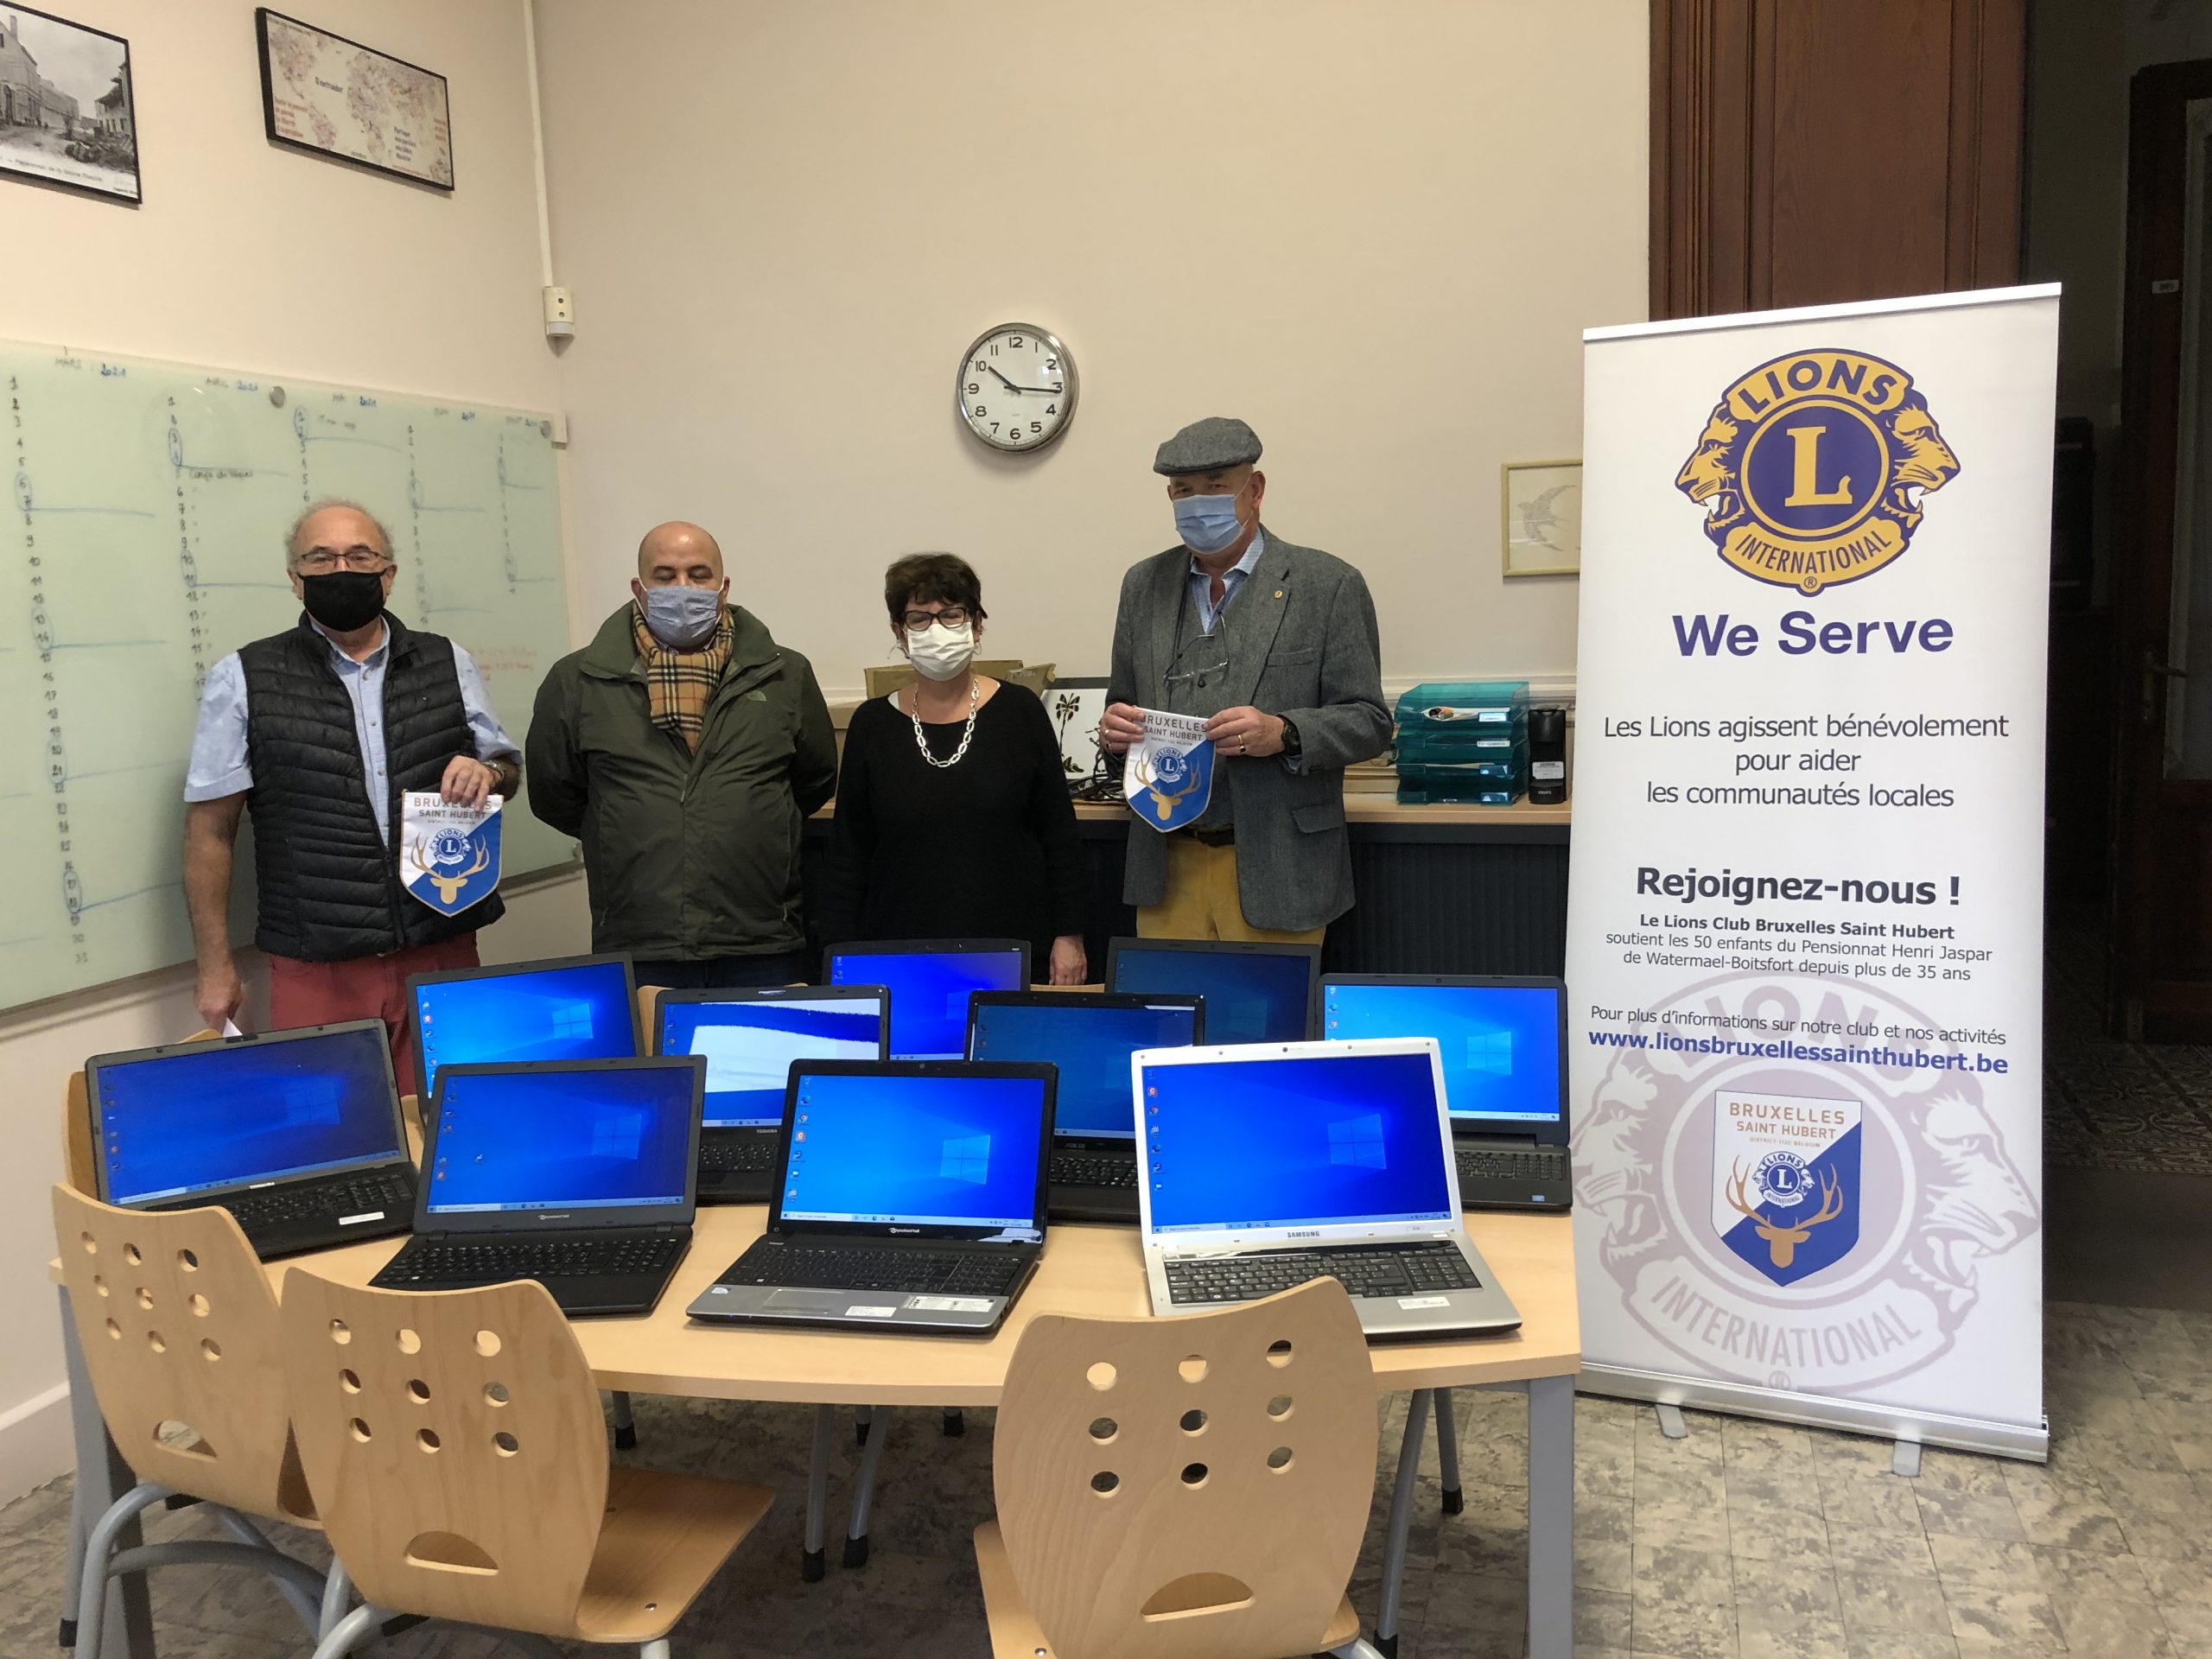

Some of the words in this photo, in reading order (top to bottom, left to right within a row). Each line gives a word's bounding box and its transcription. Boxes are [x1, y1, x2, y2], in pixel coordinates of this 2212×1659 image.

[1009, 336, 1023, 348] 12
[1034, 341, 1038, 353] 1
[990, 345, 998, 356] 11
[976, 360, 987, 372] 10
[1046, 359, 1056, 370] 2
[968, 383, 979, 394] 9
[1052, 382, 1063, 394] 3
[1738, 359, 1897, 415] LIONS
[975, 405, 987, 416] 8
[1046, 404, 1056, 415] 4
[990, 423, 1000, 434] 7
[1010, 428, 1020, 440] 6
[1030, 422, 1042, 433] 5
[1784, 426, 1853, 506] L
[1735, 531, 1891, 574] INTERNATIONAL
[1672, 614, 1758, 657] We
[1778, 611, 1953, 655] Serve
[1144, 726, 1166, 736] SAINT
[1170, 732, 1202, 741] HUBERT
[1605, 717, 1642, 737] Les
[1650, 715, 1710, 737] Lions
[1718, 715, 1818, 742] agissent
[1827, 713, 2009, 737] bénévolement
[1160, 748, 1181, 759] LIONS
[1166, 759, 1174, 771] L
[1736, 751, 1791, 776] pour
[1799, 748, 1861, 771] aider
[1648, 781, 1679, 803] les
[1687, 781, 1860, 806] communautés
[1869, 784, 1954, 807] locales
[450, 810, 486, 819] HUBERT
[440, 830, 463, 838] LIONS
[446, 839, 456, 853] L
[1637, 867, 1936, 906] Rejoignez-nous
[1950, 876, 1960, 906] !
[1640, 914, 1659, 927] Le
[1664, 915, 1707, 929] Lions
[1713, 917, 1750, 931] Club
[1756, 918, 1835, 934] Bruxelles
[1840, 922, 1886, 937] Saint
[1892, 924, 1955, 939] Hubert
[1606, 932, 1663, 946] soutient
[1669, 933, 1688, 947] les
[1694, 935, 1712, 949] 50
[1717, 937, 1772, 951] enfants
[1777, 938, 1796, 952] du
[1802, 940, 1886, 957] Pensionnat
[1892, 944, 1934, 958] Henri
[1939, 945, 1993, 963] Jaspar
[1624, 950, 1641, 963] de
[1646, 951, 1794, 972] Watermael-Boitsfort
[1799, 959, 1849, 976] depuis
[1855, 962, 1886, 978] plus
[1891, 963, 1911, 977] de
[1917, 964, 1936, 979] 35
[1942, 969, 1971, 981] ans
[1592, 1006, 1624, 1020] Pour
[1628, 1008, 1657, 1024] plus
[1771, 1020, 1796, 1032] sur
[1801, 1020, 1841, 1034] notre
[1847, 1021, 1878, 1037] club
[1884, 1025, 1900, 1039] et
[1905, 1028, 1934, 1040] nos
[1939, 1028, 2006, 1045] activités
[1588, 1031, 2008, 1074] www.lionsbruxellessainthubert.be
[1730, 1103, 1845, 1124] BRUXELLES
[1737, 1121, 1777, 1134] SAINT
[1782, 1125, 1836, 1139] HUBERT
[1767, 1154, 1802, 1167] LIONS
[1777, 1168, 1792, 1188] L
[1766, 1192, 1800, 1204] INTERNATIONAL
[1651, 1275, 1922, 1368] INTERNATIONAL
